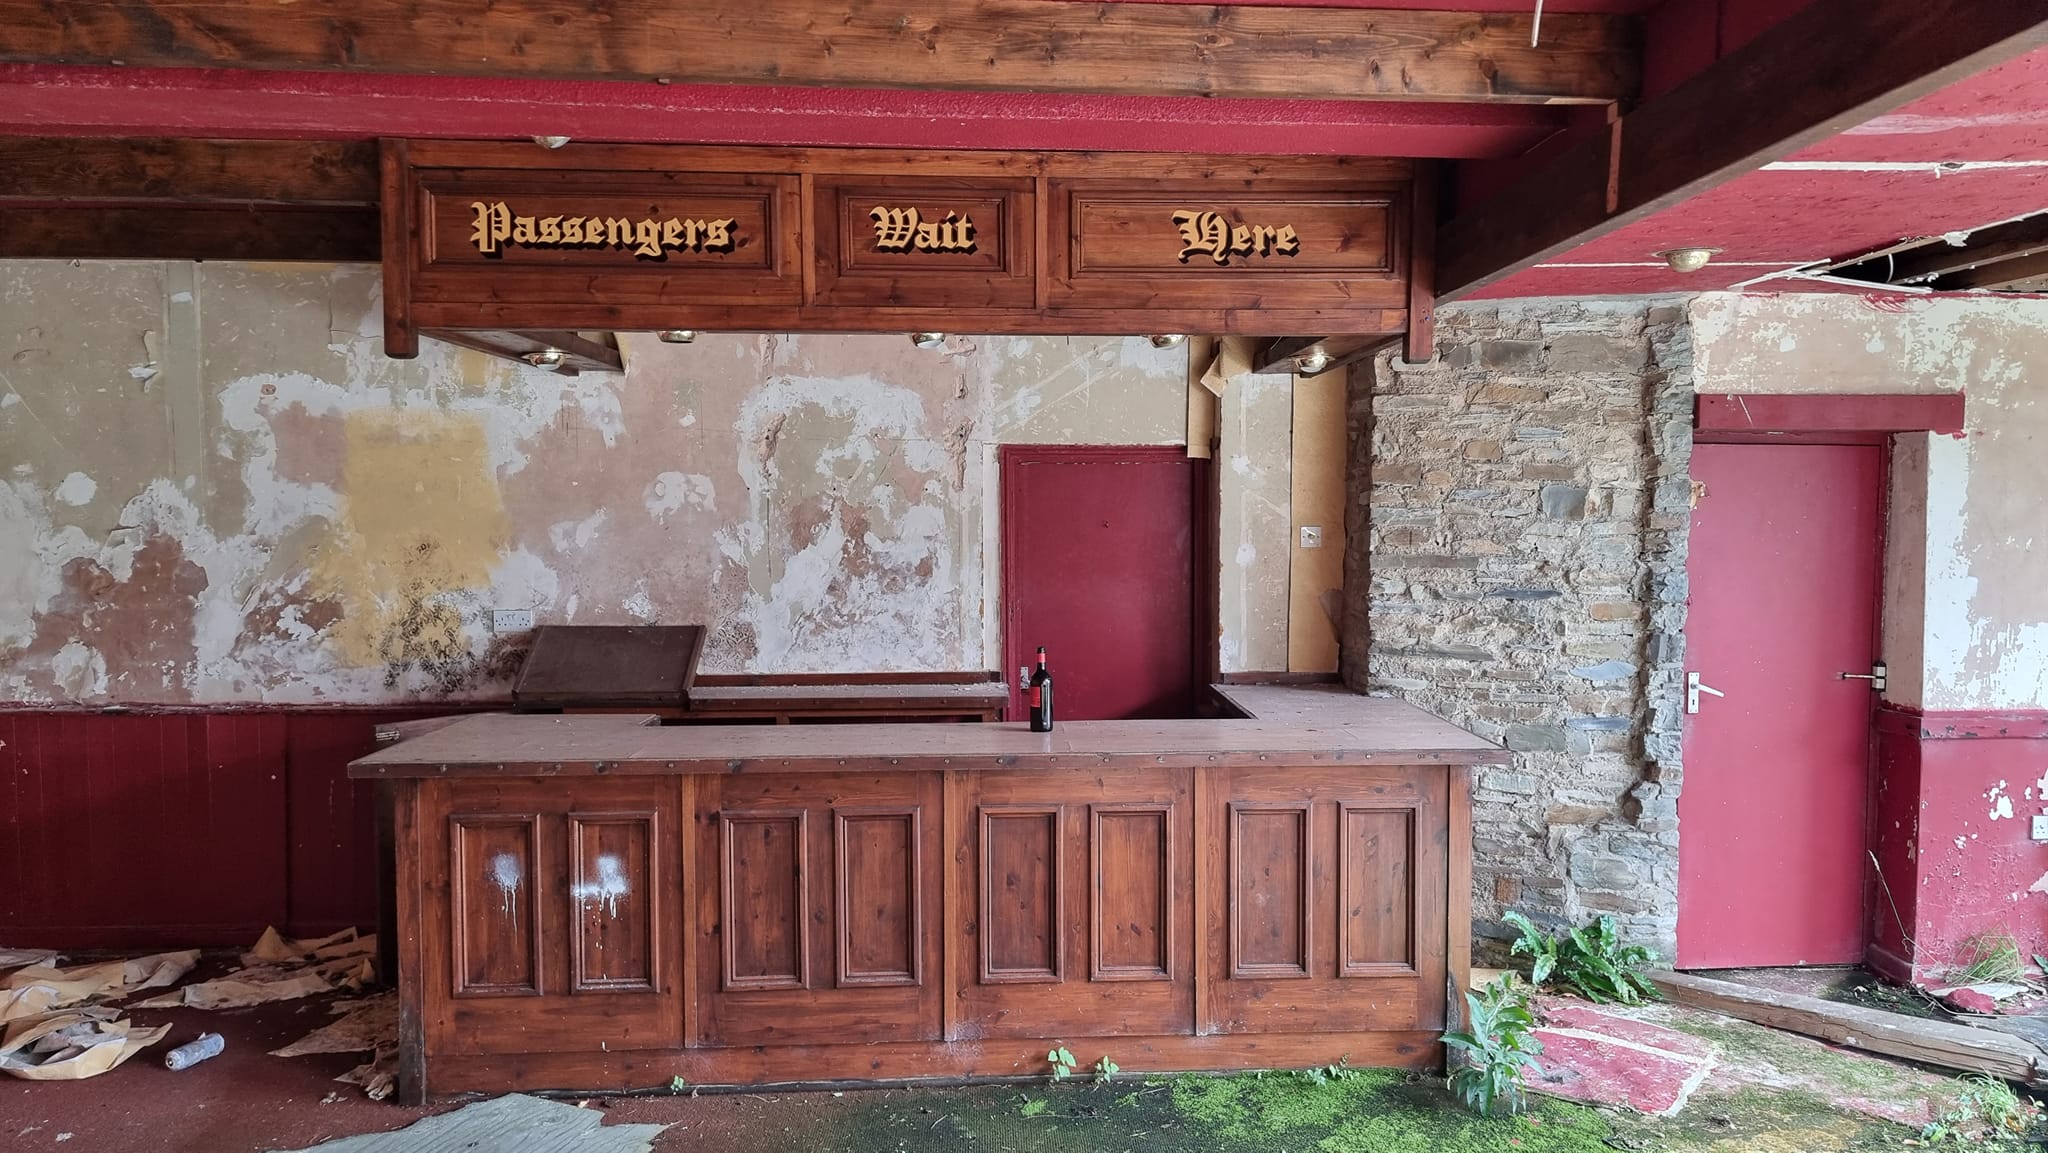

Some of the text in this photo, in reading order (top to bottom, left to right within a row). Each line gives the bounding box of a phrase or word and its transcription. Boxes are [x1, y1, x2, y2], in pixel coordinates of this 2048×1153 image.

[470, 201, 1299, 262] Passengers Wait Here
